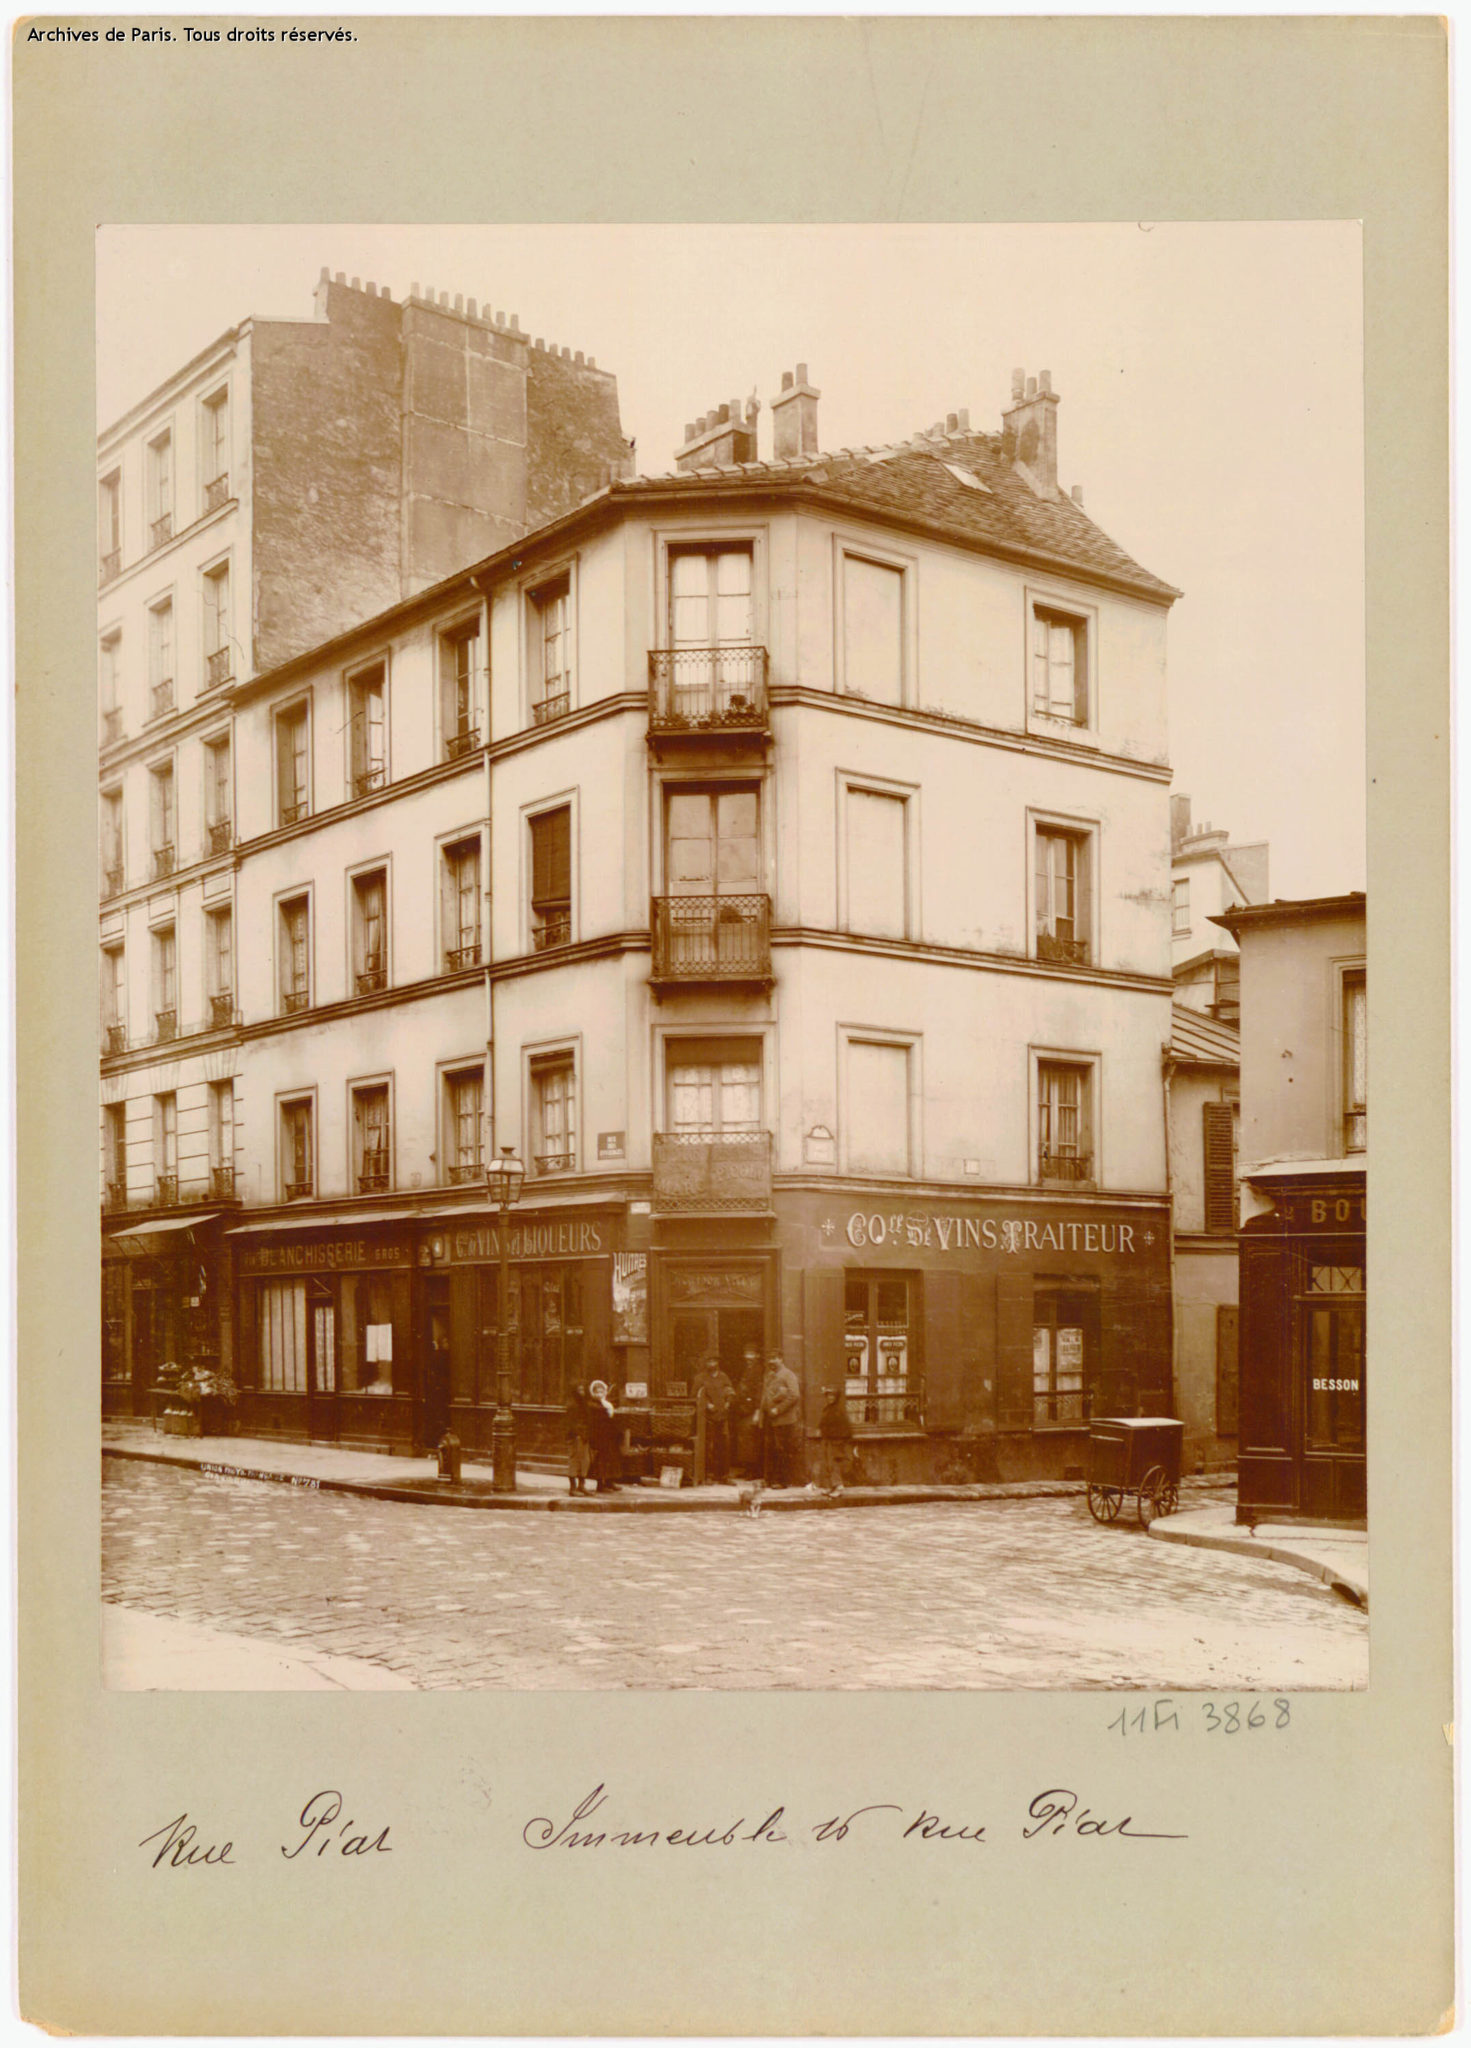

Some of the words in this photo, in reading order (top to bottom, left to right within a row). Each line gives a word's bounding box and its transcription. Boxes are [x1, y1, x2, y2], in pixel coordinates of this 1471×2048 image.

[260, 1240, 366, 1268] BLANCHISSERIE
[477, 1228, 510, 1257] VIN
[520, 1221, 601, 1258] LIQUEURS
[1001, 1220, 1136, 1254] TRAITEUR
[1313, 1378, 1359, 1391] BESSON
[1201, 1698, 1291, 1734] 3868
[281, 1790, 393, 1859] Piat
[523, 1783, 788, 1849] Immeuble
[1023, 1788, 1188, 1839] Piat
